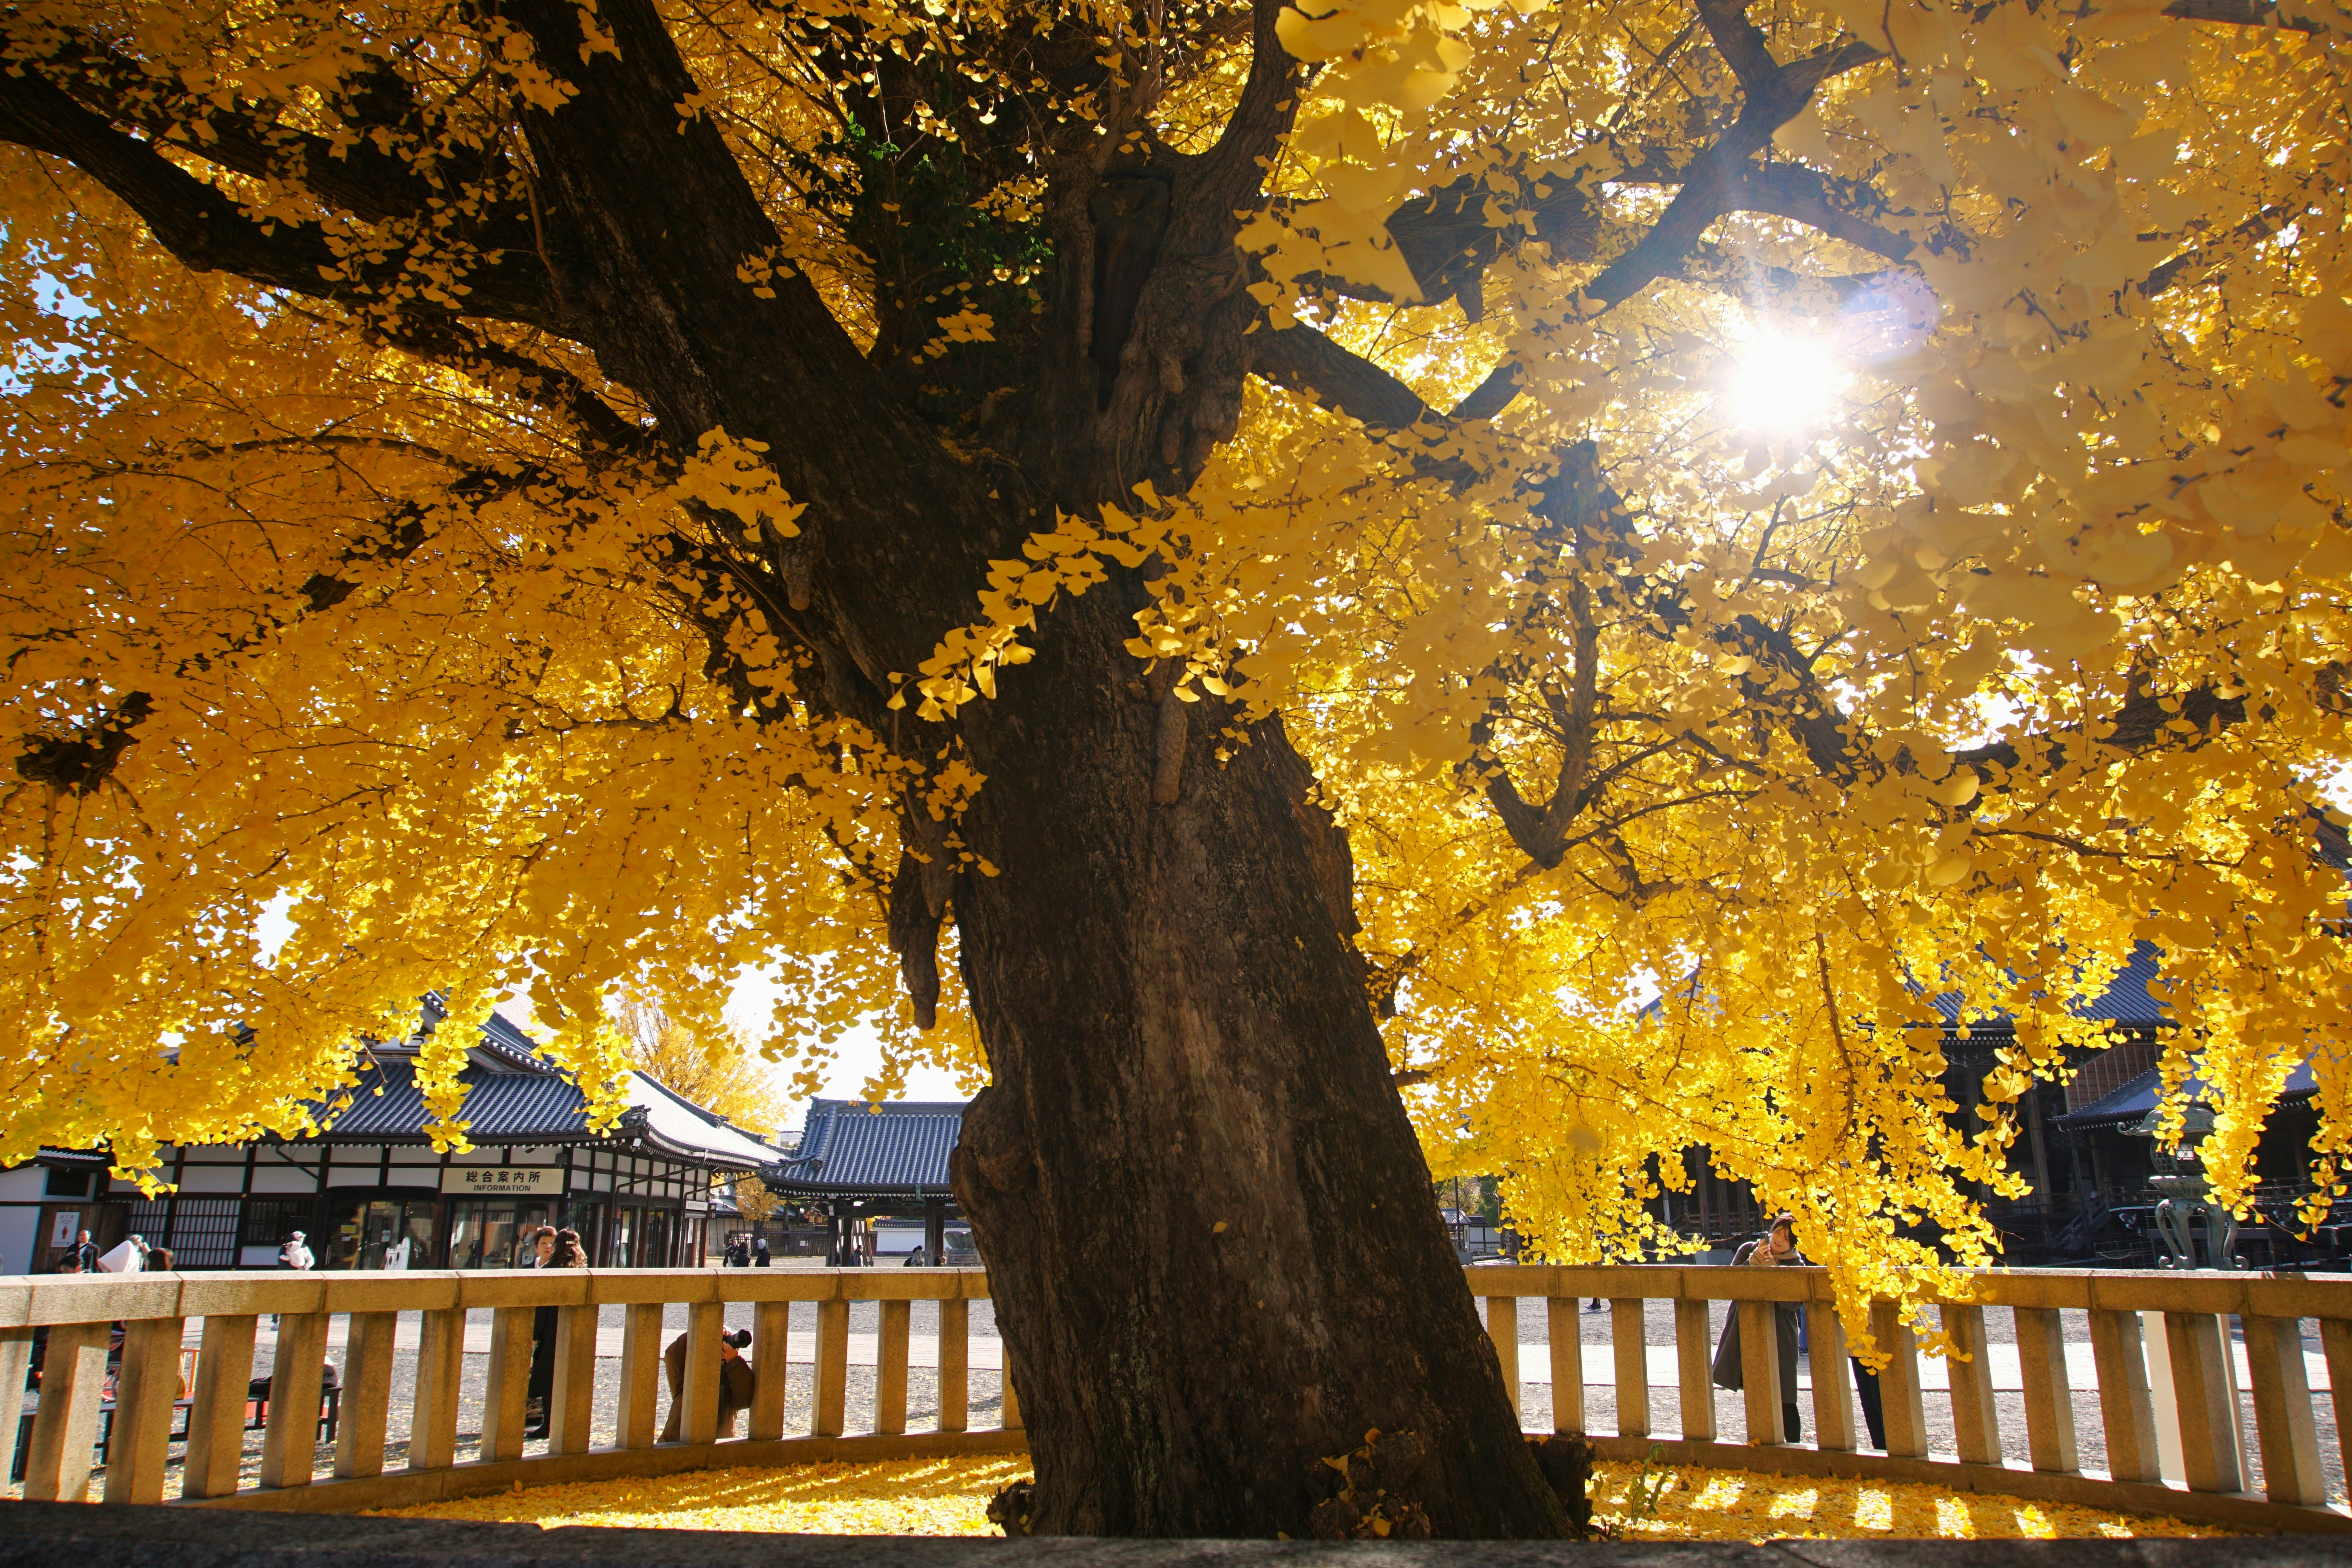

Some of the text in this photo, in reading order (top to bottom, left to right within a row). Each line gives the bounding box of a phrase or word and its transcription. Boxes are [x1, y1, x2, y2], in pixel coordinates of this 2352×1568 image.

[466, 1171, 541, 1183] 総合案内所
